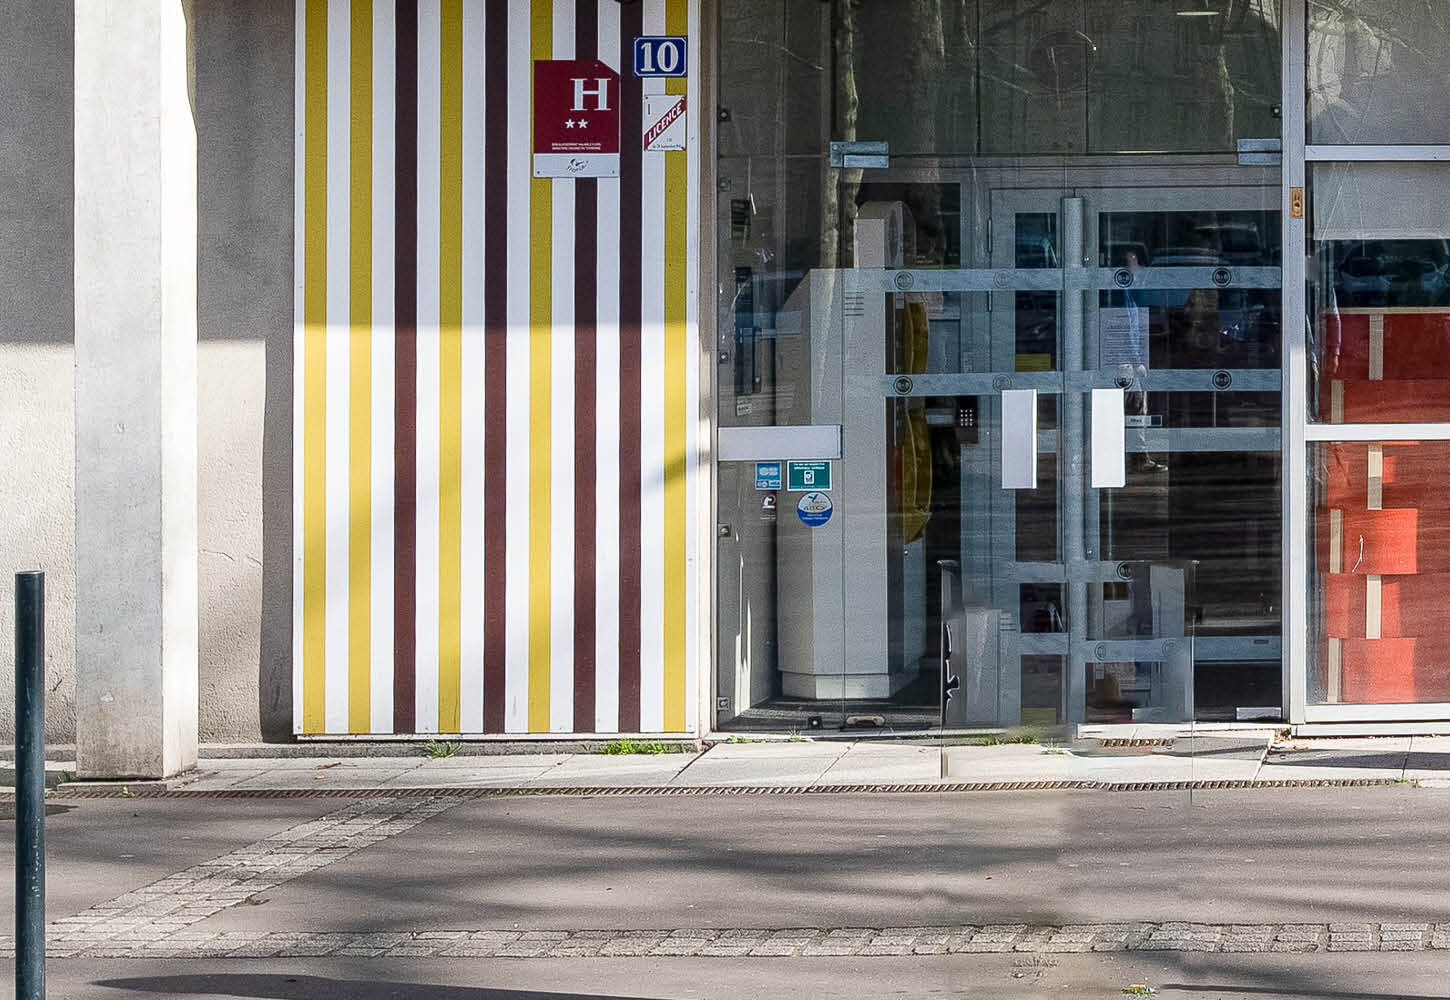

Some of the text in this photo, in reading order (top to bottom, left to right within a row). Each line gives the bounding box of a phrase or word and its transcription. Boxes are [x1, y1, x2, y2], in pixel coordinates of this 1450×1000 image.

[641, 41, 679, 73] 10
[569, 77, 613, 112] H
[648, 102, 682, 143] LICENCE
